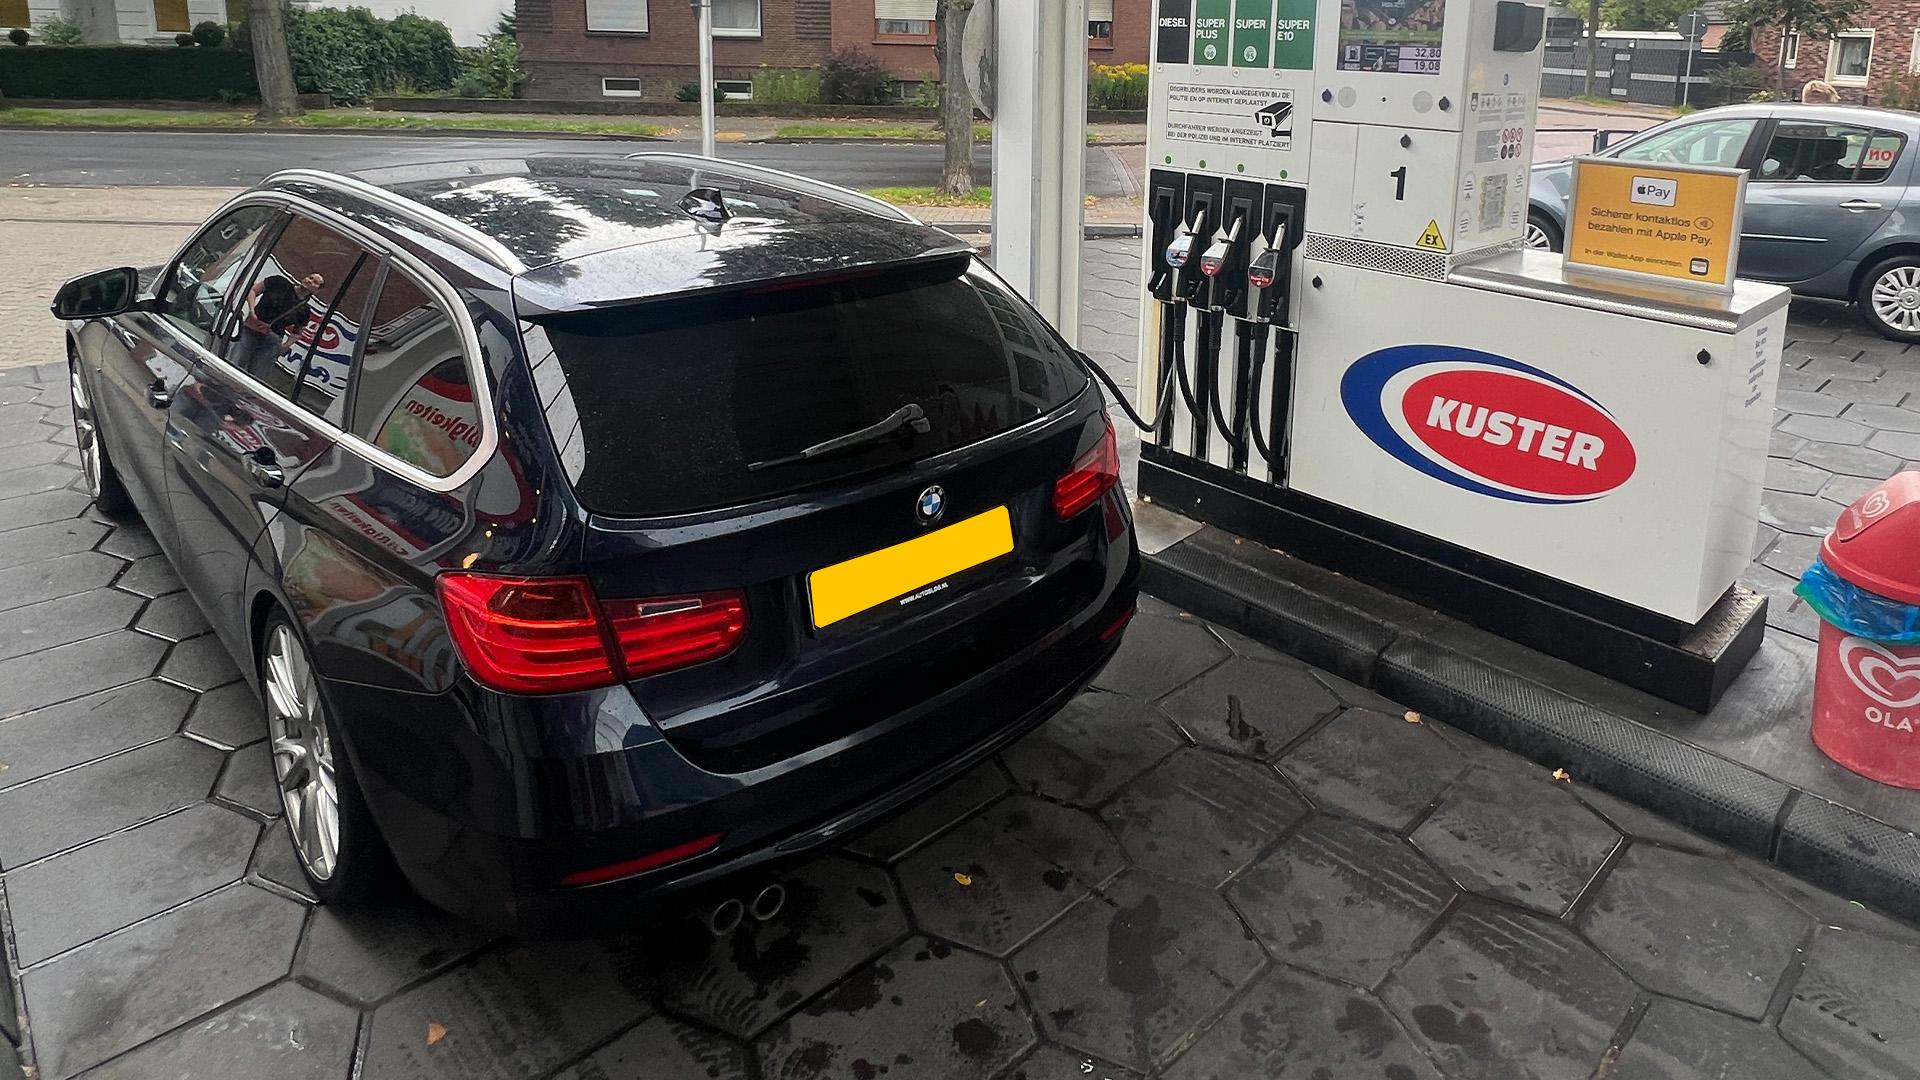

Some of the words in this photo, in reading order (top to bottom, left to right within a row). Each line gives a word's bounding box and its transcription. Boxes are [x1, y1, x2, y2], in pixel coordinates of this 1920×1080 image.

[1159, 17, 1188, 28] DIESEL
[1197, 18, 1225, 28] SUPER
[1235, 19, 1266, 29] SUPER
[1278, 19, 1310, 30] SUPER
[1196, 29, 1218, 39] PLUS
[1277, 30, 1294, 41] E10
[1415, 48, 1441, 58] 32,80
[1414, 61, 1440, 71] 19,08
[1234, 98, 1268, 106] GEPLAATST
[1167, 122, 1206, 131] DURCHFAHRER
[1231, 128, 1263, 136] ANGEZEIGT
[1230, 137, 1257, 145] INTERNET
[1258, 139, 1290, 148] PLATZIERT
[1390, 166, 1407, 201] 1
[1647, 185, 1671, 200] Pay
[1591, 207, 1633, 220] Sicherer
[1636, 212, 1691, 227] kontaktlos
[1424, 232, 1440, 246] EX
[1587, 221, 1633, 235] bezahlen
[1636, 227, 1653, 238] mit
[1655, 229, 1687, 242] Apple
[1690, 233, 1713, 247] Pay.
[1425, 394, 1605, 472] KUSTER
[1864, 706, 1914, 733] OLA
